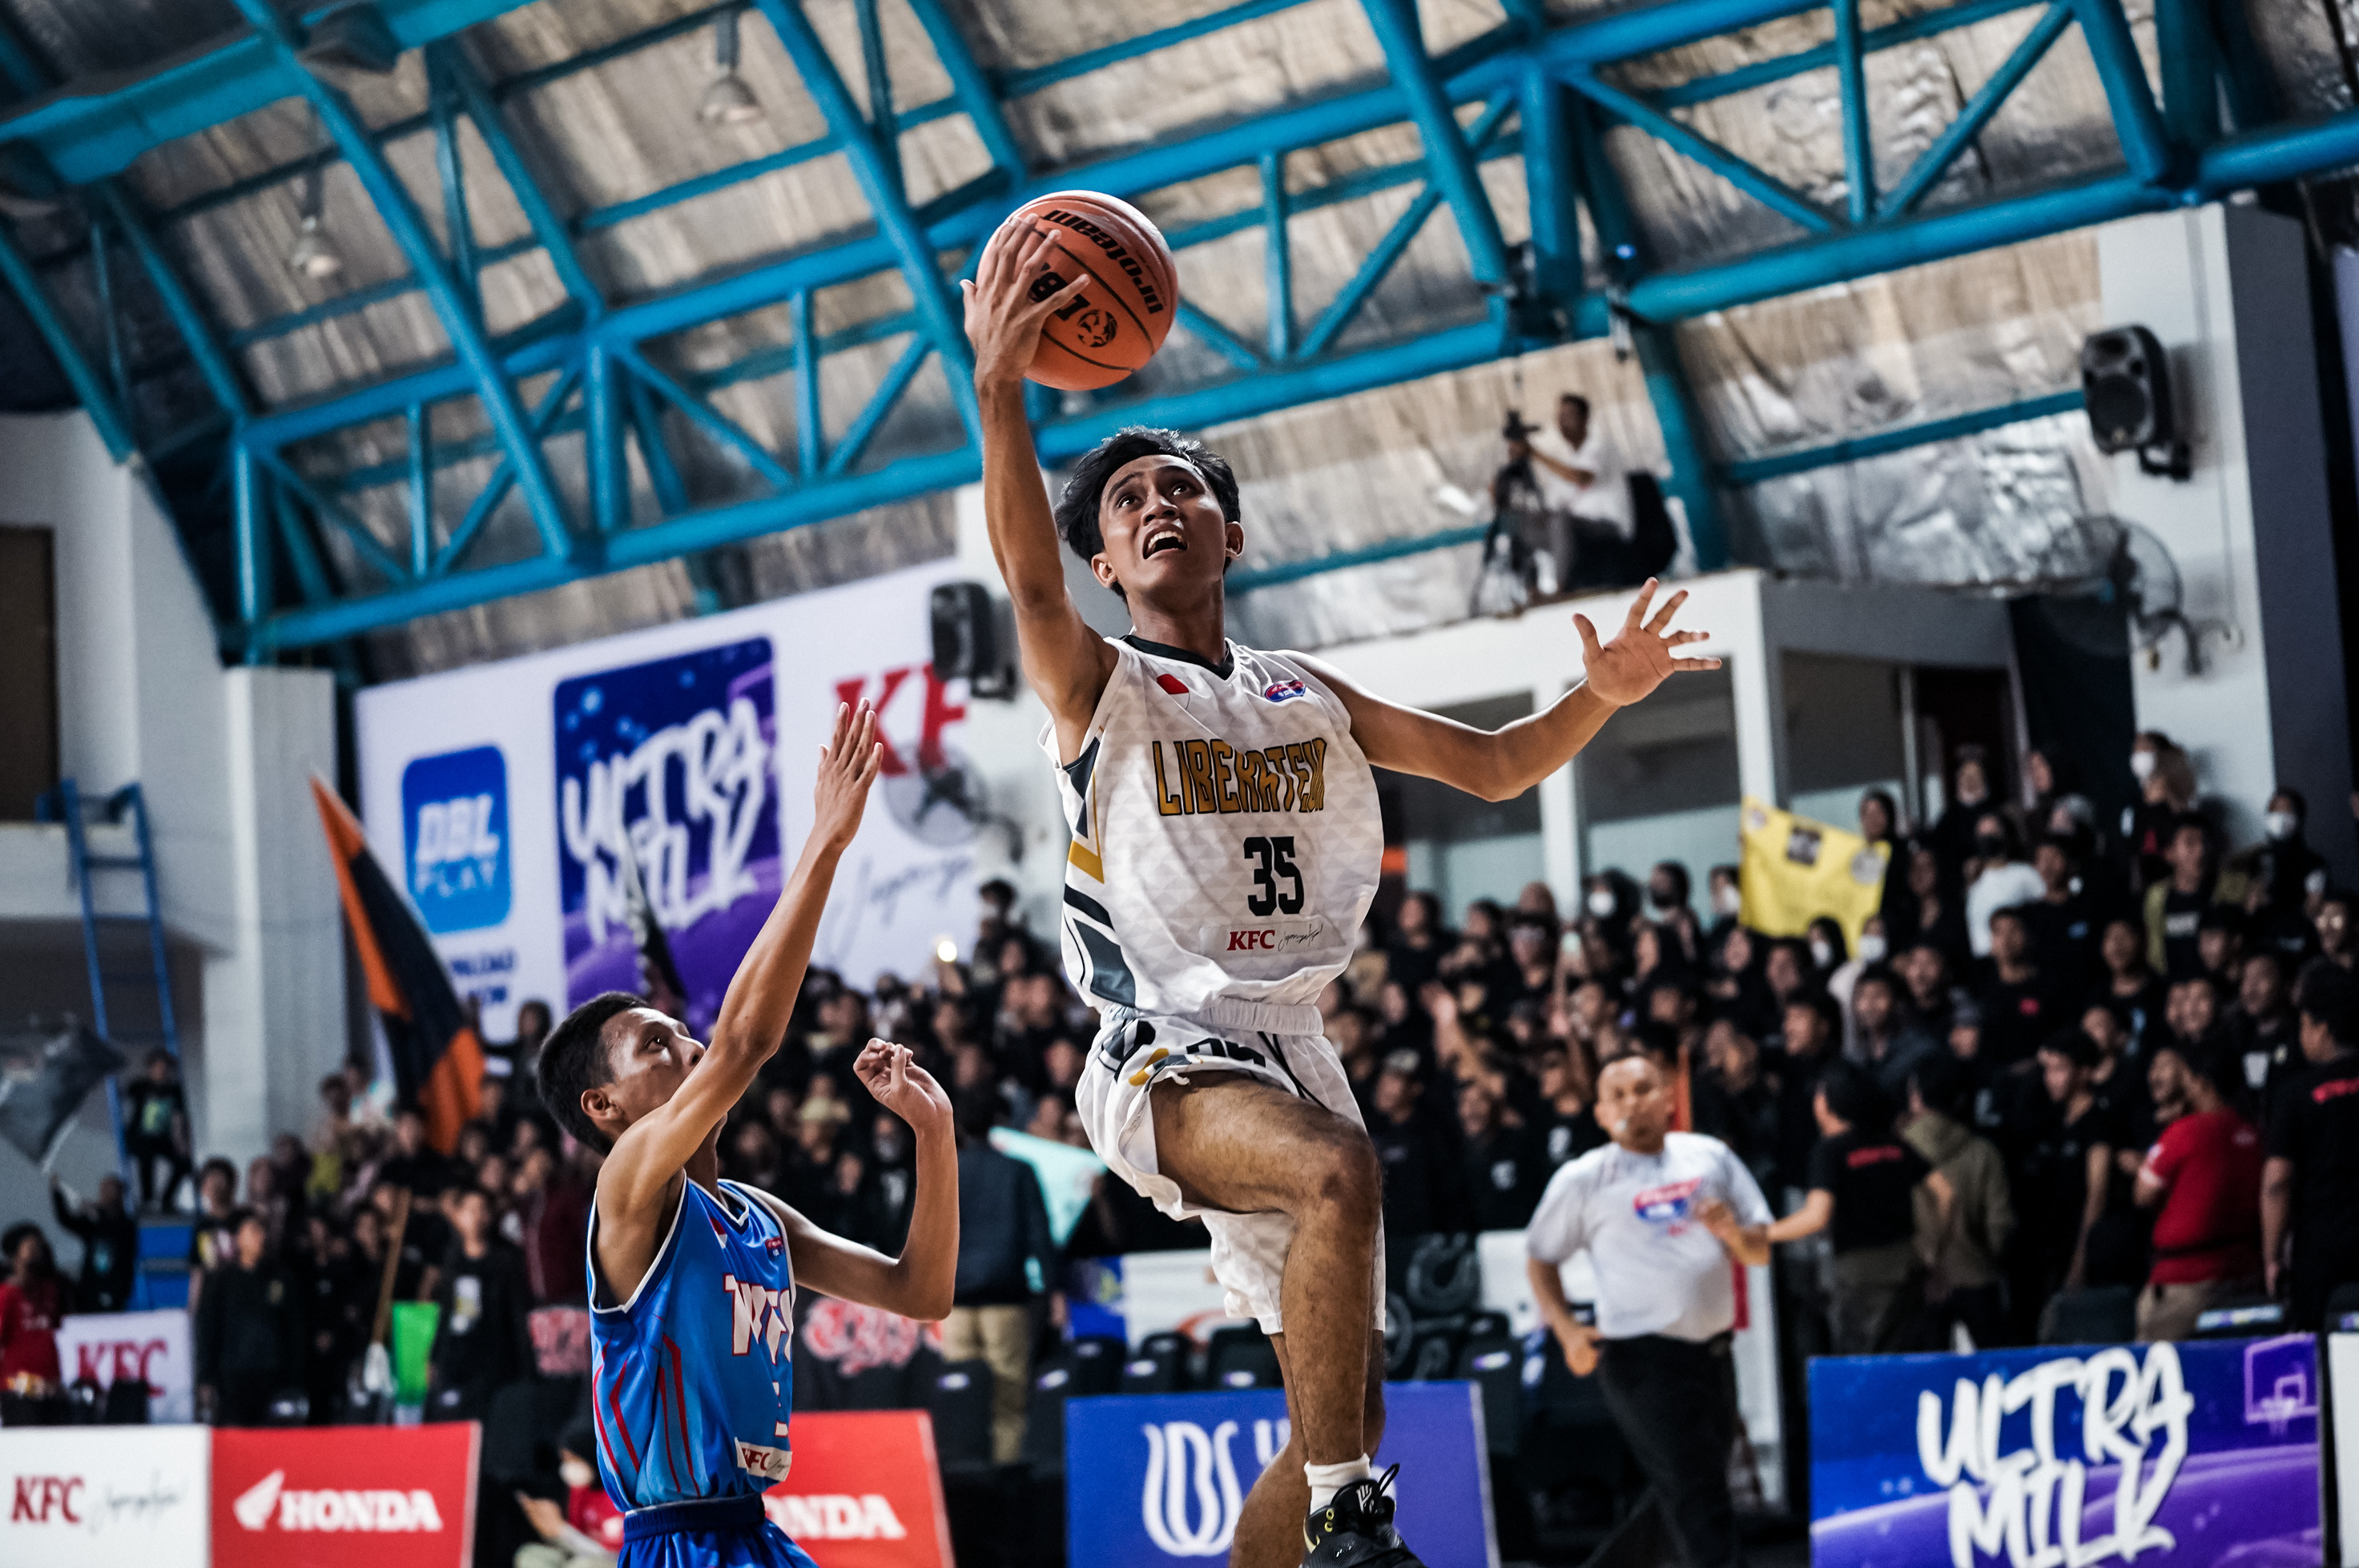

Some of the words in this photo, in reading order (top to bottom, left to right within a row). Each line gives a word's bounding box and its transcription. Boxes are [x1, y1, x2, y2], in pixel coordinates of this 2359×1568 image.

[1043, 209, 1164, 315] proteam
[416, 793, 501, 863] DBL
[1243, 836, 1305, 917] 35
[1226, 930, 1276, 951] KFC
[1916, 1340, 2196, 1488] ULTRA
[11, 1475, 84, 1525] KFC
[279, 1488, 444, 1533] HONDA
